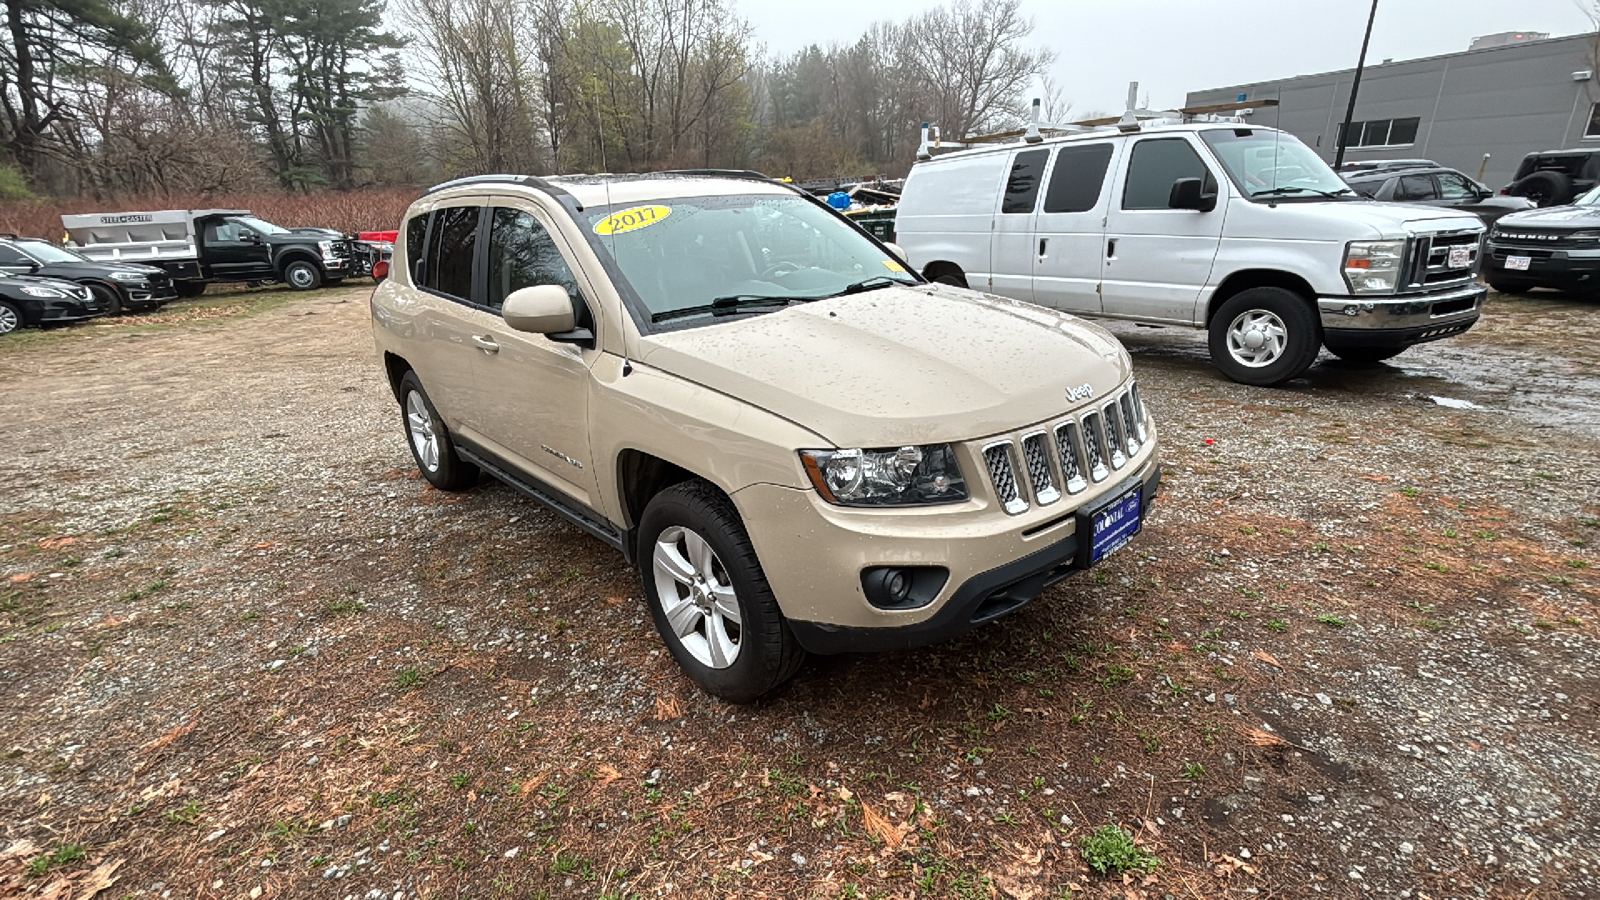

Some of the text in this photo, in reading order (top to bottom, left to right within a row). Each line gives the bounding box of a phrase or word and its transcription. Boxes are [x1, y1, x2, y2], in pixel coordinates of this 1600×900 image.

[608, 207, 656, 231] 2017
[1065, 382, 1094, 403] Jeep
[1093, 506, 1125, 537] COLONIAL
